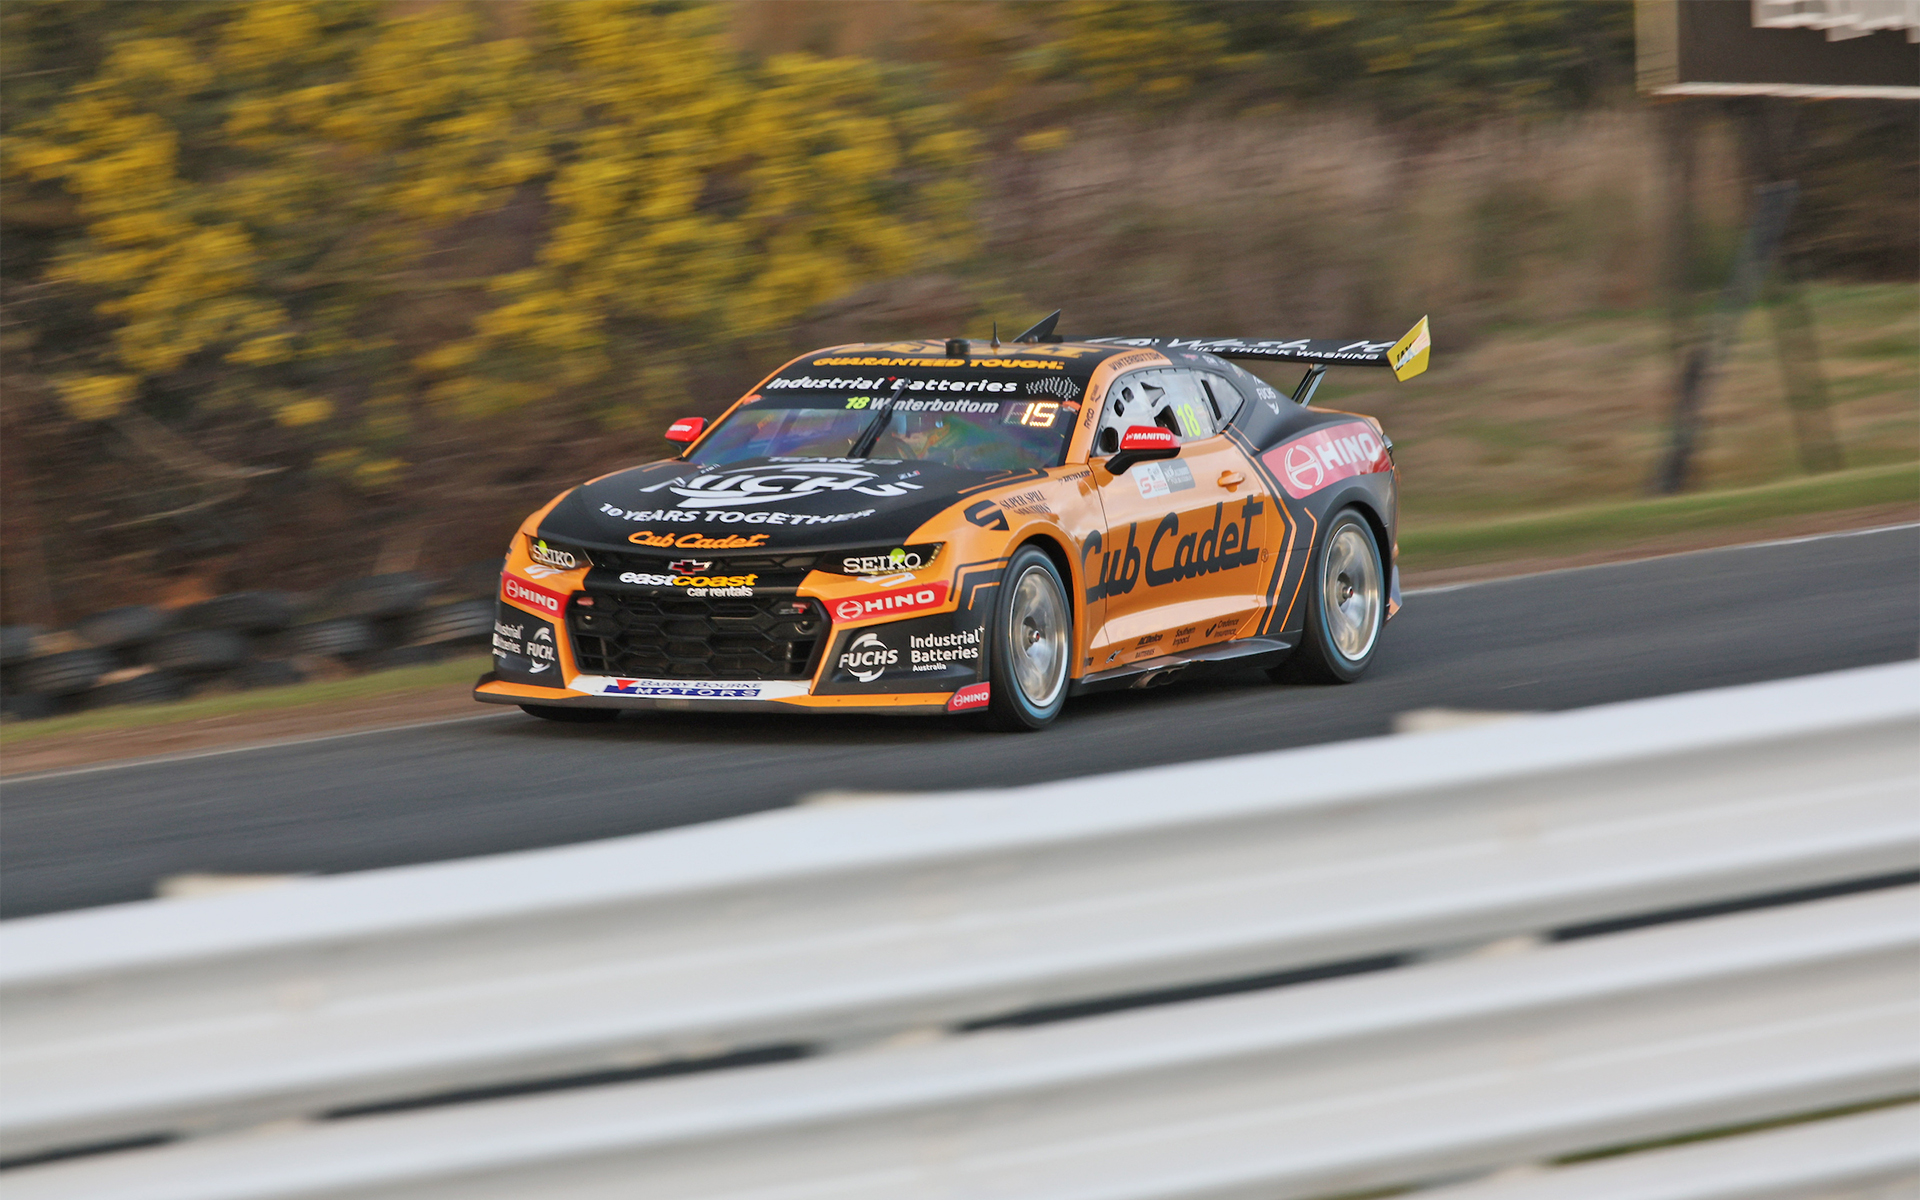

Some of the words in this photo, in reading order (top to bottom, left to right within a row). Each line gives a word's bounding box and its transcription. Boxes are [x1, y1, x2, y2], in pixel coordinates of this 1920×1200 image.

[812, 357, 966, 368] GUARANTEED
[1108, 352, 1165, 371] WINTERBOTTOM
[1231, 347, 1292, 356] TRUCK
[1295, 350, 1380, 360] WASHING
[766, 376, 885, 390] Industrial
[890, 378, 1018, 392] Batteries
[1256, 387, 1277, 400] FUCHS
[845, 396, 871, 410] 18
[869, 397, 999, 413] Wnterbottom
[1176, 403, 1201, 437] 18
[1133, 432, 1171, 441] MANITOU
[1315, 432, 1378, 471] HINO
[1062, 470, 1091, 482] DUNLOP
[999, 495, 1026, 510] SUPER
[1024, 490, 1047, 504] SPILL
[599, 503, 623, 517] 10
[623, 509, 701, 522] YEARS
[628, 531, 675, 548] Cub
[675, 533, 770, 549] Cadet
[1081, 522, 1141, 605] Cub
[1145, 494, 1264, 587] Cadet
[532, 543, 576, 568] SEIKO
[843, 552, 921, 573] SEIKO
[518, 586, 559, 611] HINO
[686, 586, 709, 597] car
[709, 585, 753, 597] rentals
[865, 589, 935, 613] HINO
[910, 630, 981, 649] Industrial
[526, 641, 556, 661] FUCH
[838, 649, 899, 669] FUCHS
[910, 645, 979, 664] Batteries
[912, 662, 947, 673] Australia
[635, 687, 757, 697] MOTORS
[962, 692, 989, 703] HINO
